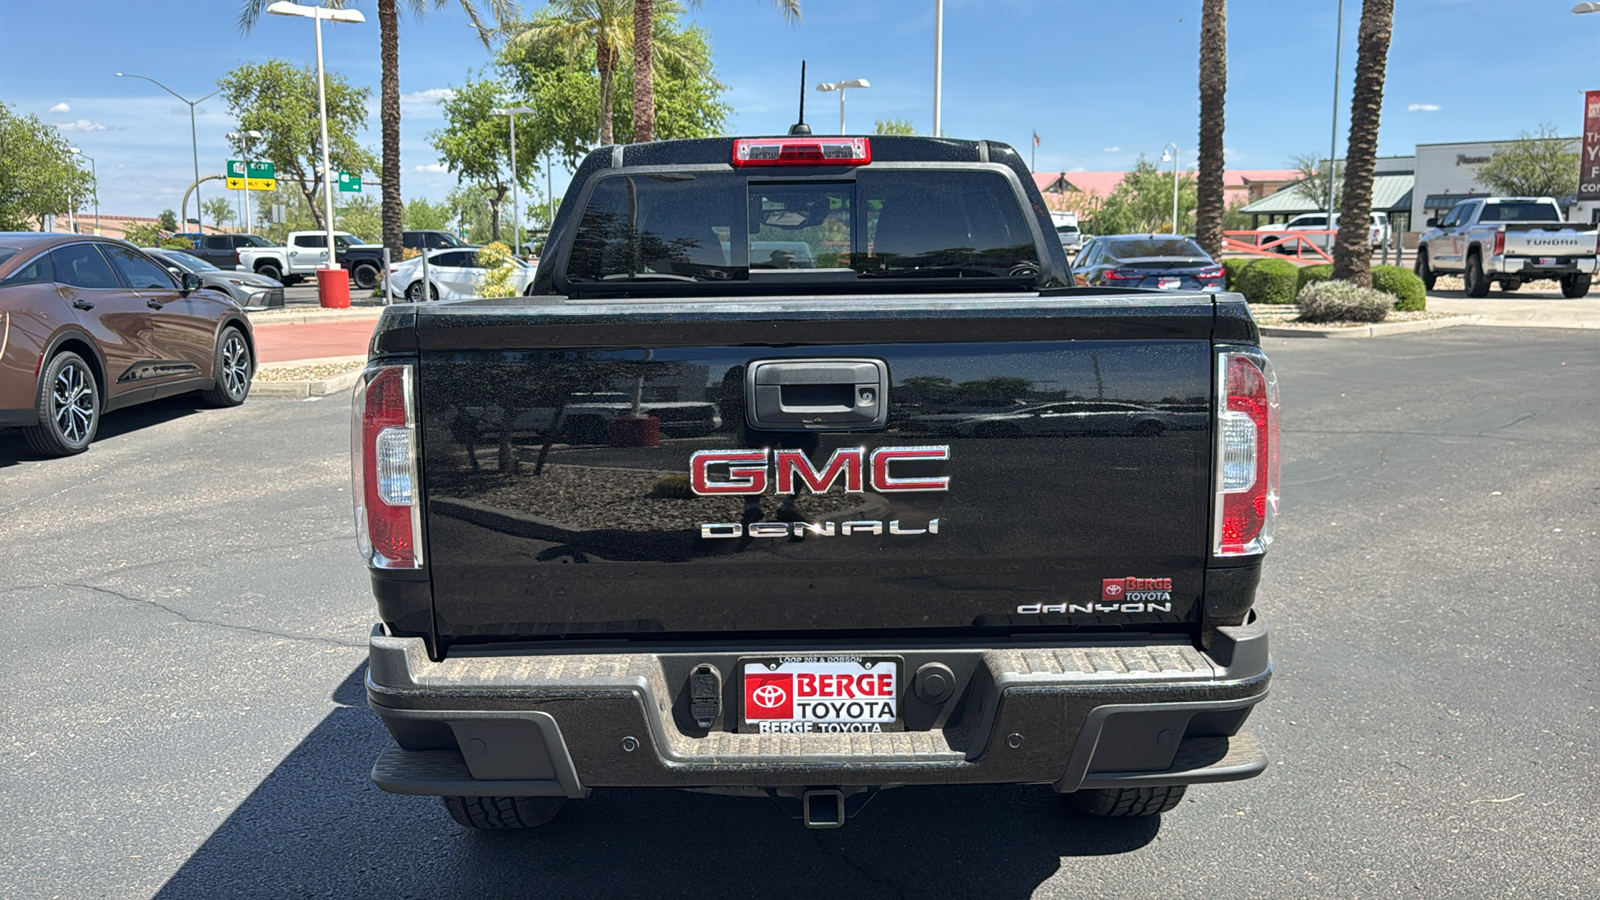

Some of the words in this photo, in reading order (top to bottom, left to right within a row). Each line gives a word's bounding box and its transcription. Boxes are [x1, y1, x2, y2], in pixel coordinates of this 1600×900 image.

[689, 445, 950, 496] GMC
[701, 518, 939, 538] DENALI
[1125, 576, 1172, 590] BERGE
[1125, 592, 1171, 601] TOYOTA
[1016, 602, 1172, 614] CANYON
[797, 673, 894, 699] BERGE
[797, 702, 895, 719] TOYOTA
[759, 721, 813, 734] BERGE
[819, 723, 882, 733] TOYOTA
